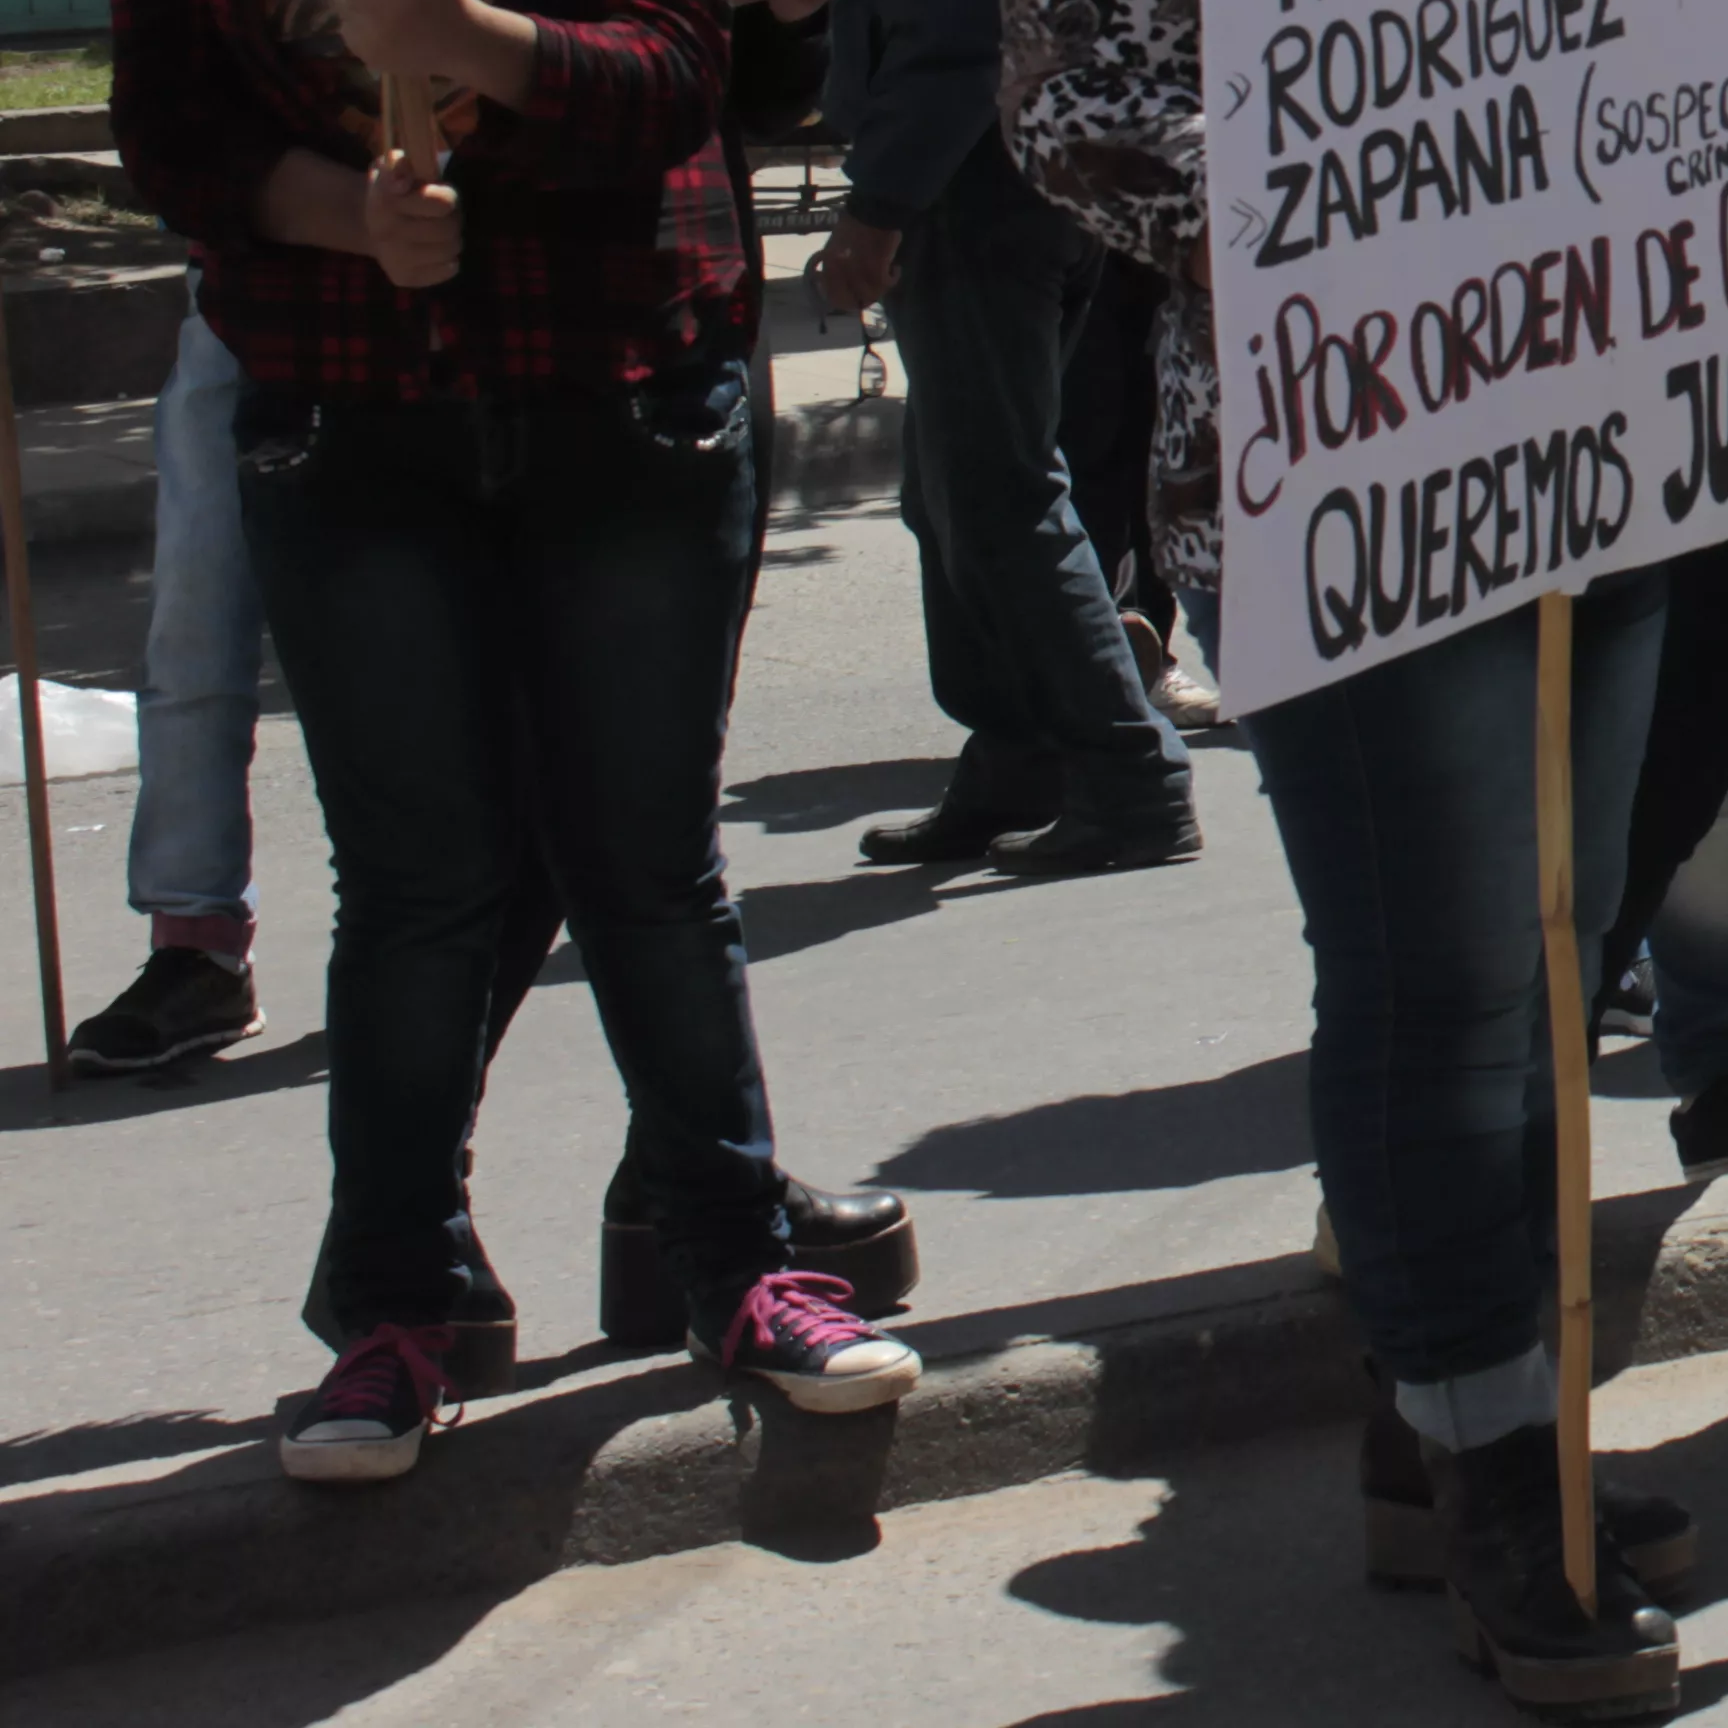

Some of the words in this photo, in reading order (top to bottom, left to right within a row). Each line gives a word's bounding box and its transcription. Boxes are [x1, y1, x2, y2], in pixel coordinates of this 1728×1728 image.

[1255, 85, 1550, 269] ZAPANA
[1410, 237, 1612, 413] ORDEN
[1635, 220, 1705, 340] DE
[1306, 412, 1633, 661] QUEREMOS
